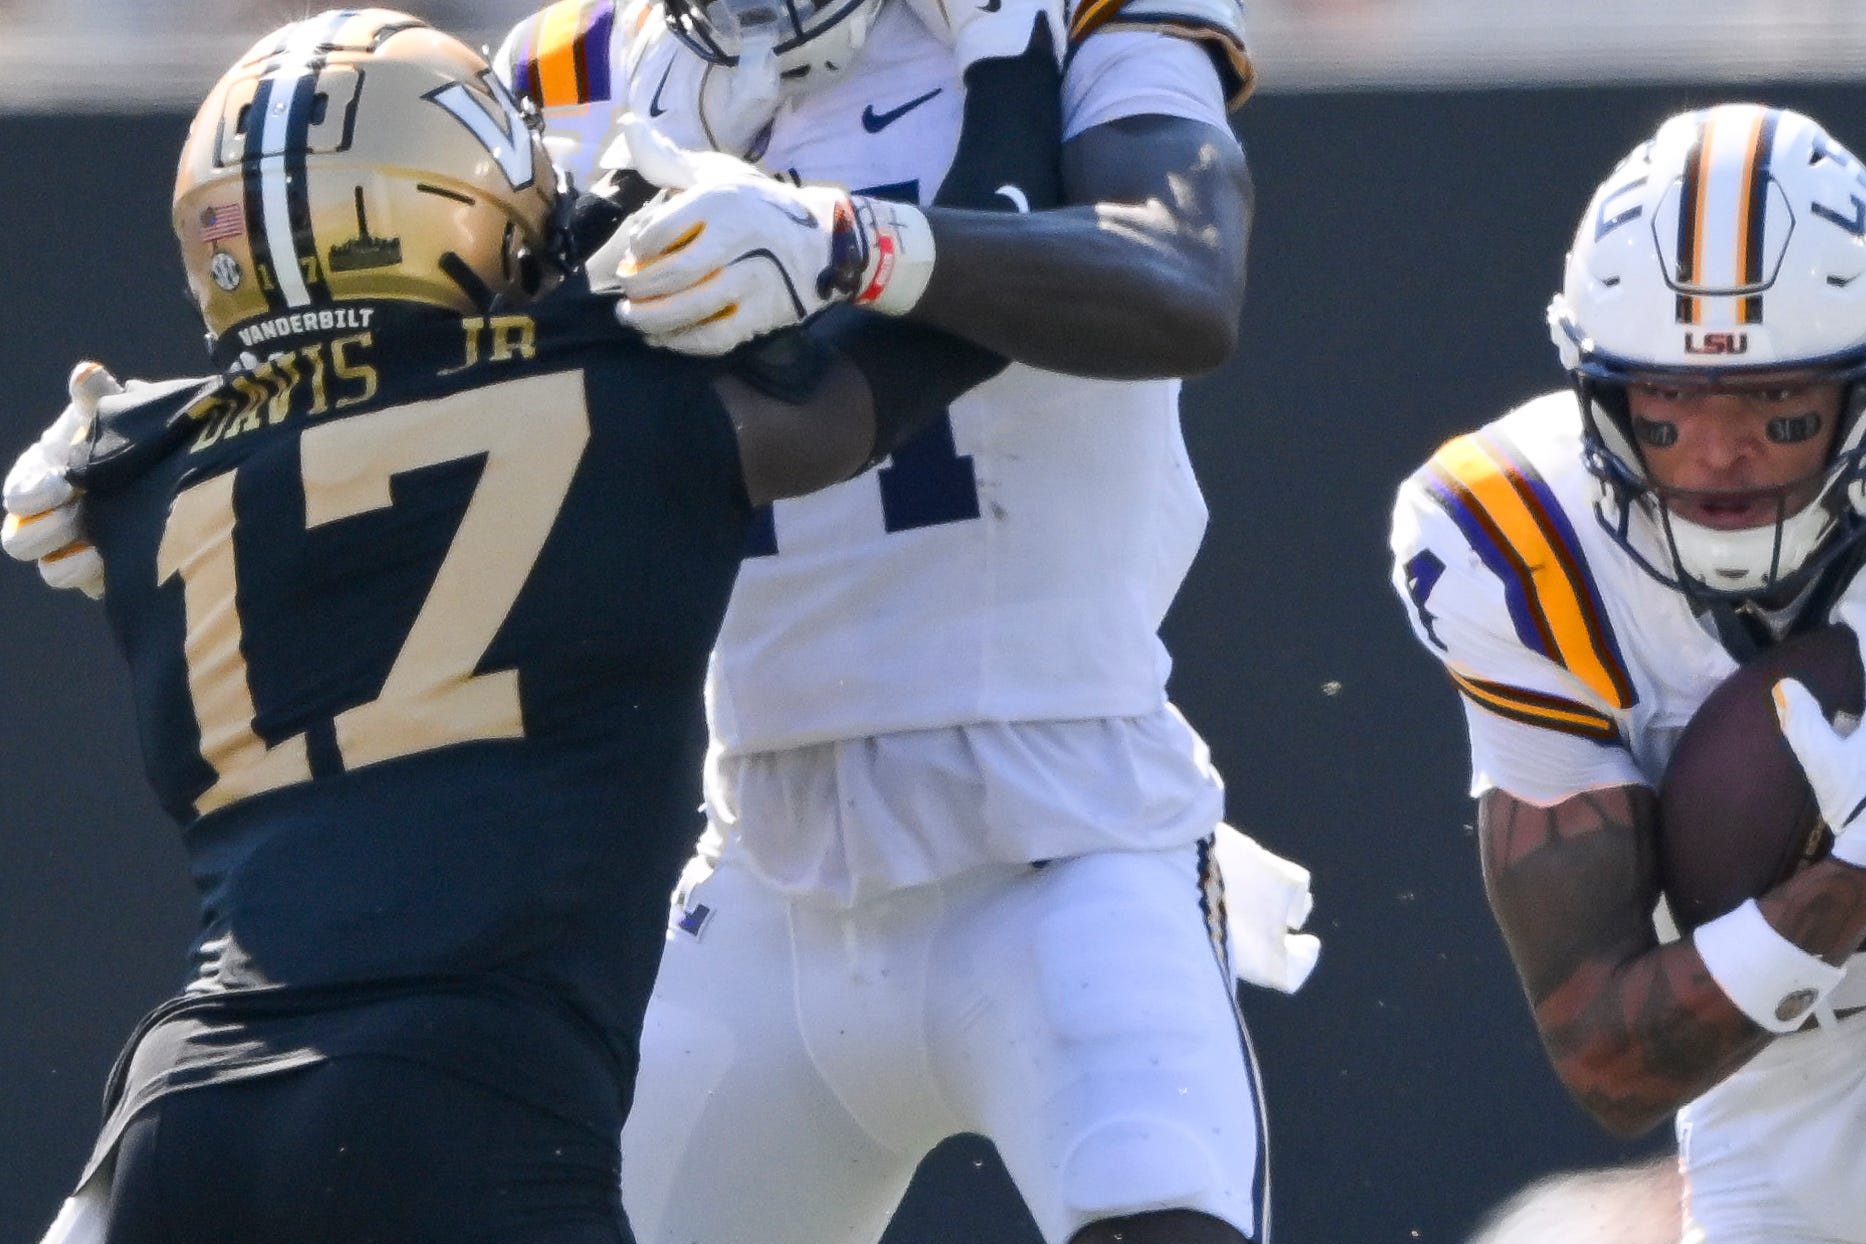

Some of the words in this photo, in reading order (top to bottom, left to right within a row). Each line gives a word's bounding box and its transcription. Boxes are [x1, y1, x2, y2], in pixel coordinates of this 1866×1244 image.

[419, 68, 536, 193] V
[237, 307, 375, 347] VANDERBILT
[436, 314, 537, 377] JR
[1684, 332, 1748, 355] LSU
[156, 367, 593, 817] 17
